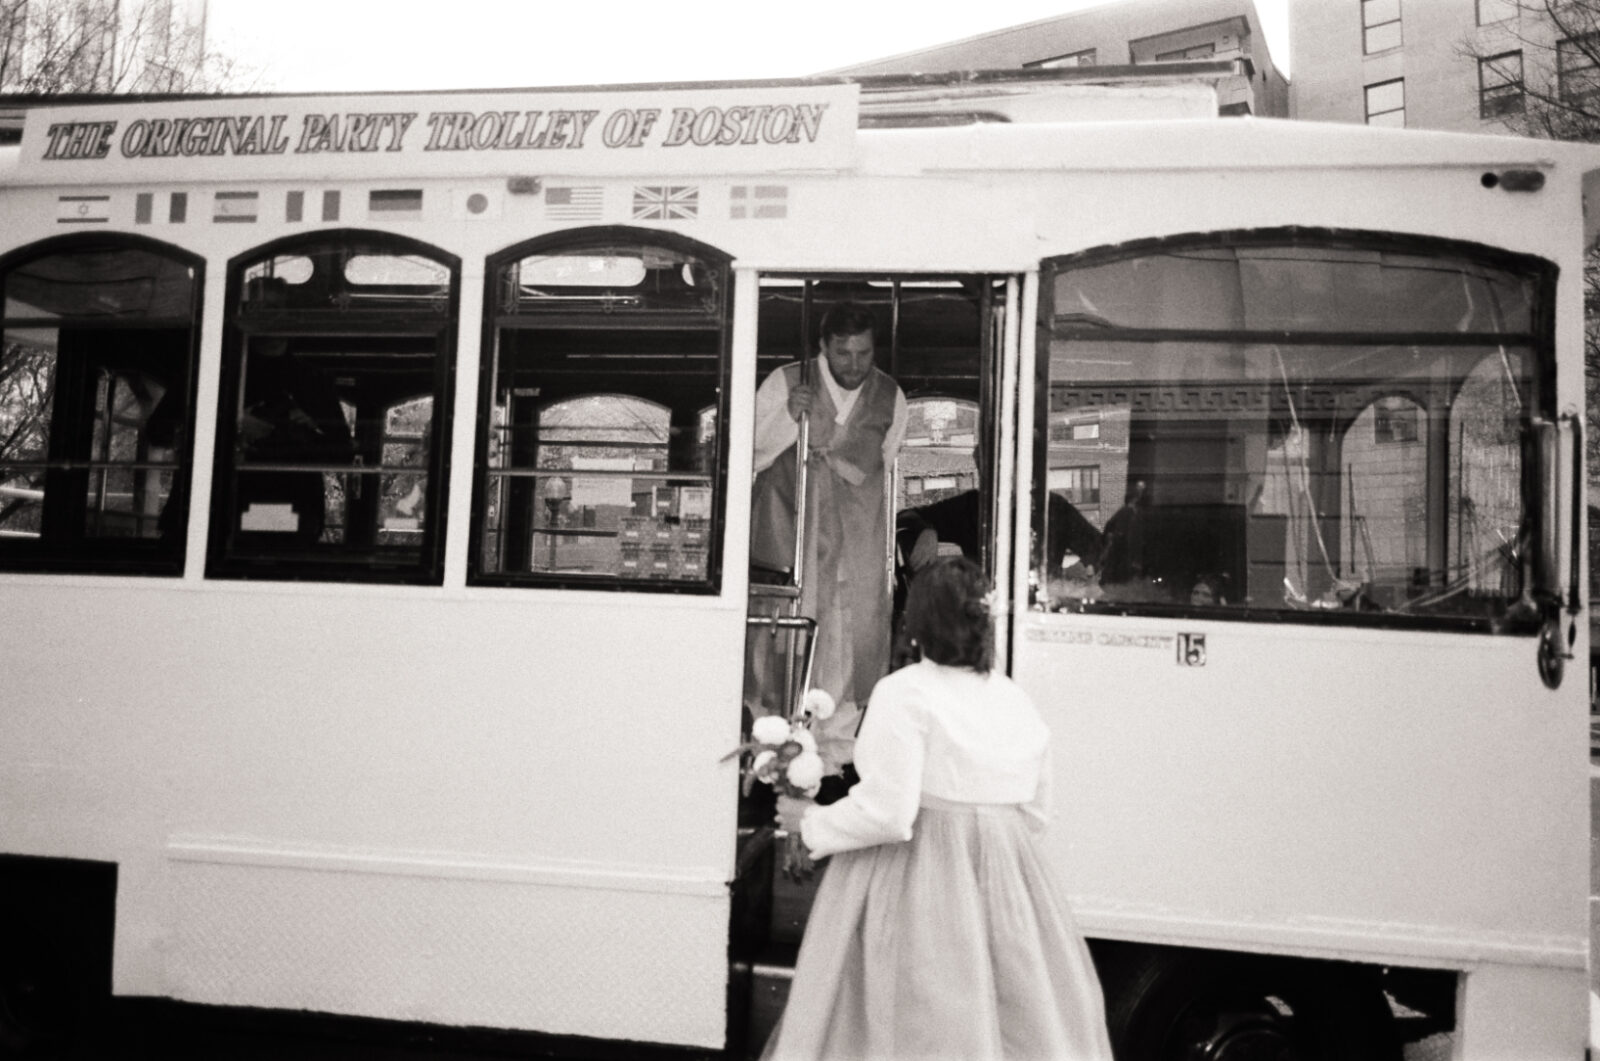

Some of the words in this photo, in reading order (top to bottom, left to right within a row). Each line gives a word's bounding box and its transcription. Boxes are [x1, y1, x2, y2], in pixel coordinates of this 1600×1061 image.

[42, 122, 116, 160] THE
[120, 115, 288, 158] ORIGINAL
[294, 112, 417, 153] PARTY
[424, 110, 599, 151] TROLLEY
[602, 108, 661, 148] OF
[662, 103, 828, 147] BOSTON
[1177, 632, 1206, 667] 15
